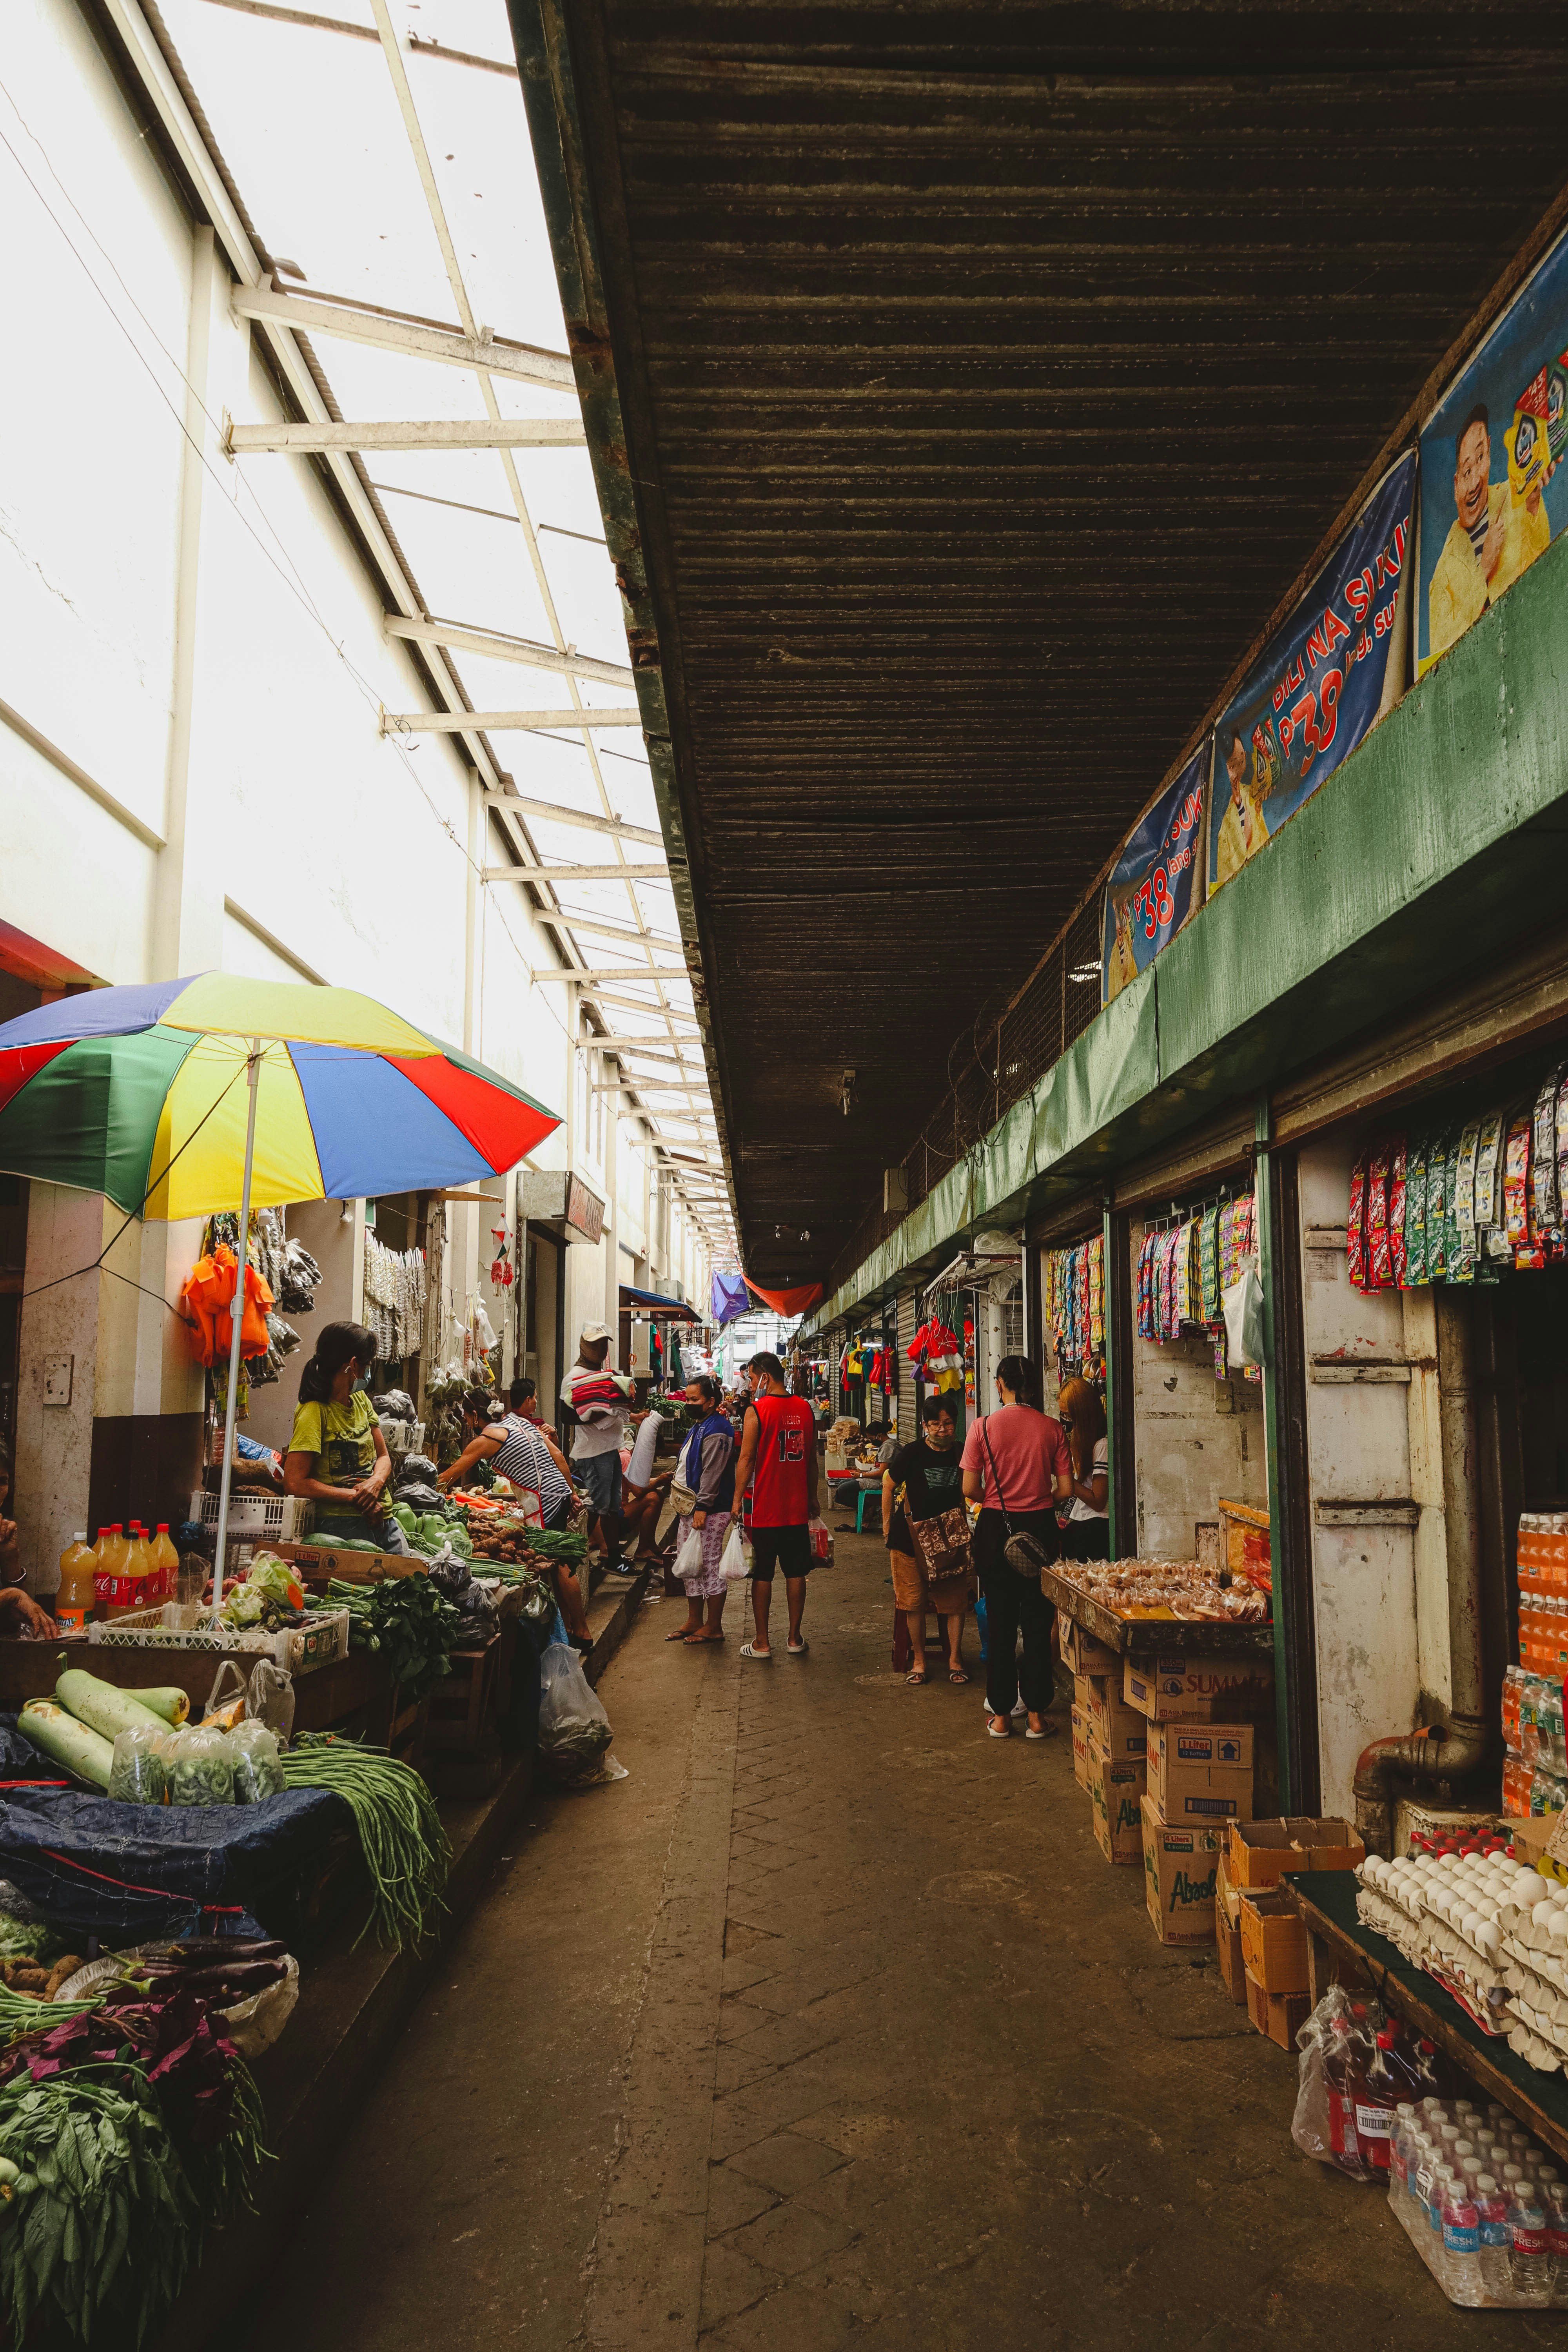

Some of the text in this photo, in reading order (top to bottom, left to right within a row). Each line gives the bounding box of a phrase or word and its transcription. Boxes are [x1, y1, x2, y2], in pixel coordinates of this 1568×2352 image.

[1306, 606, 1351, 667] NA
[1189, 1740, 1209, 1749] Liter
[1169, 1869, 1217, 1912] Absol
[1513, 2225, 1525, 2237] RE
[1514, 2236, 1543, 2248] FRESH
